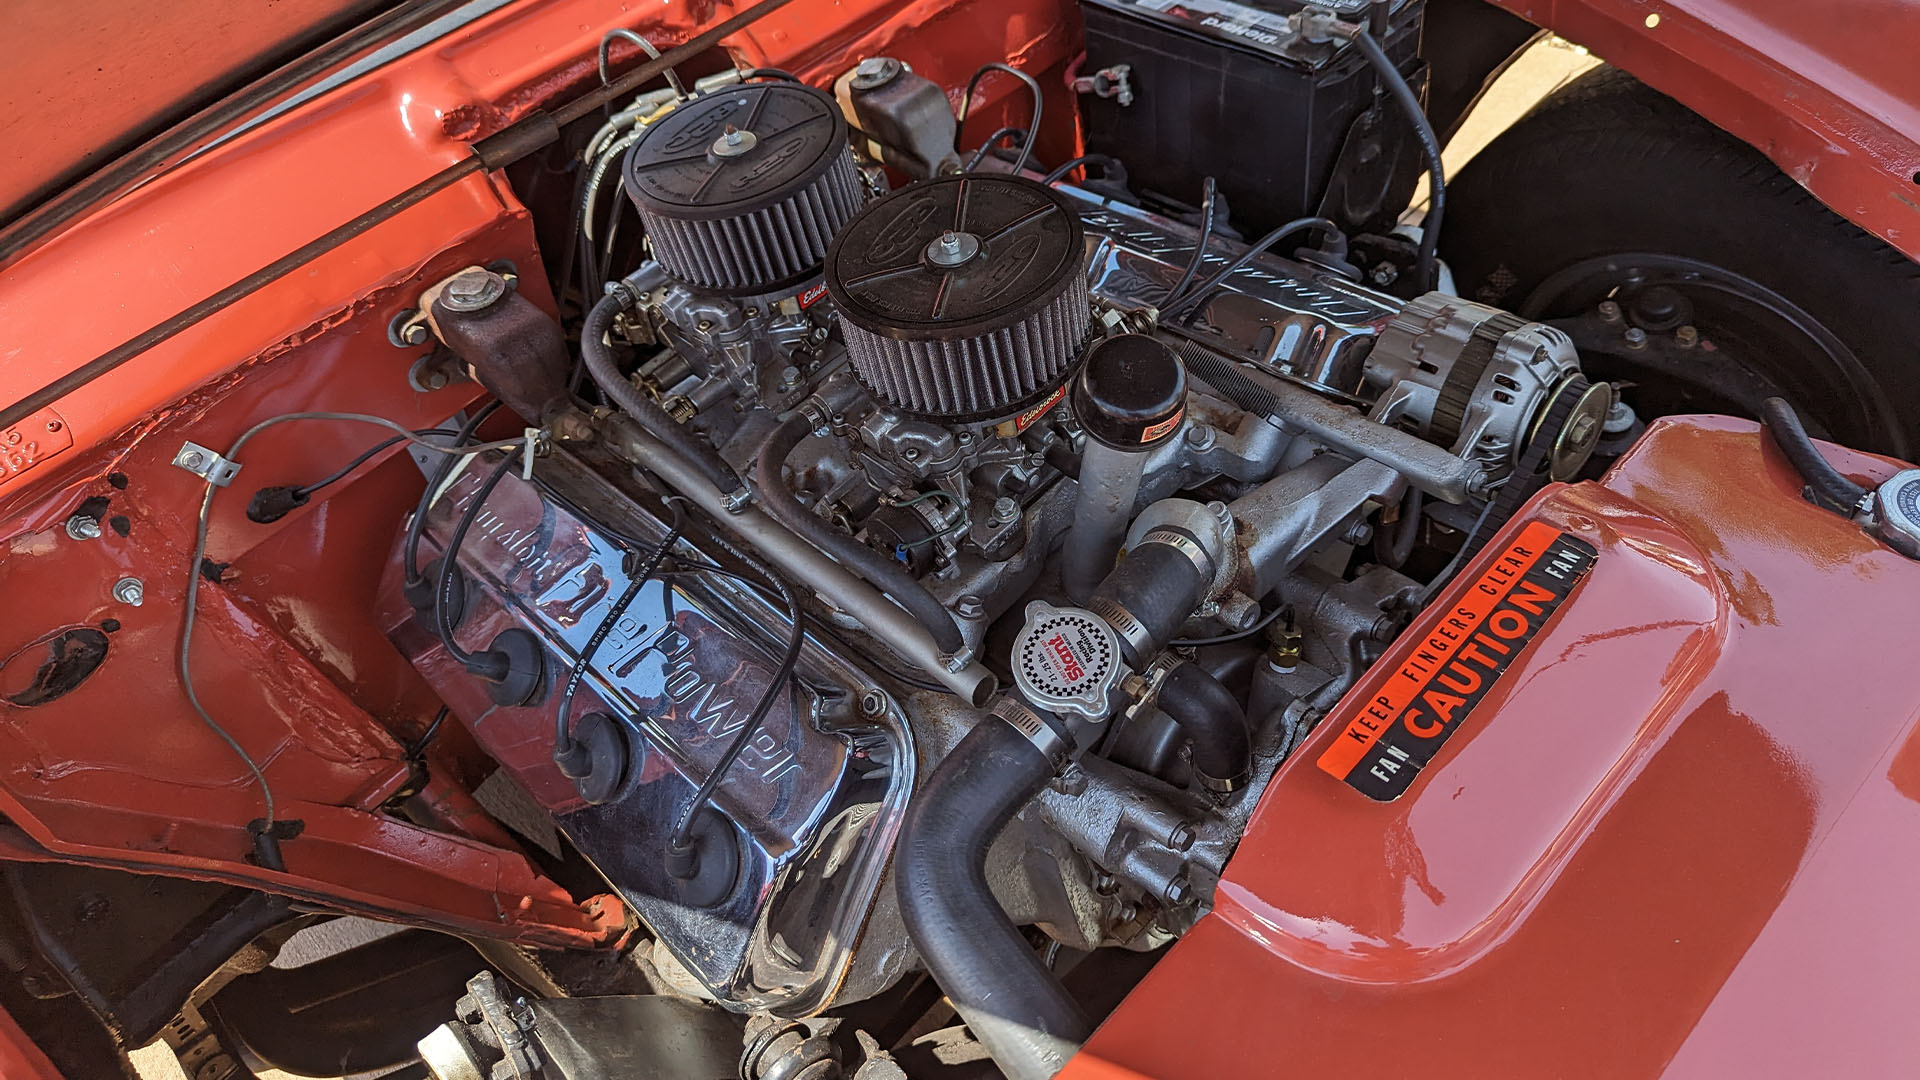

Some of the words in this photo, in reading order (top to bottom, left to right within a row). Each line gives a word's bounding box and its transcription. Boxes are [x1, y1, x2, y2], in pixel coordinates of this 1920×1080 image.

[803, 280, 828, 304] Edelb
[566, 658, 587, 697] TAYLOR
[591, 625, 608, 647] SPIRO
[607, 609, 619, 625] PRO
[1048, 635, 1085, 681] Stant
[1076, 640, 1093, 663] Racing
[1077, 628, 1096, 654] Division
[1347, 695, 1396, 744] KEEP
[1402, 606, 1477, 683] FINGERS
[1479, 545, 1533, 596] CLEAR
[1042, 662, 1057, 682] 21-25
[1370, 745, 1410, 783] FAN
[1403, 580, 1557, 739] CAUTION
[1545, 549, 1581, 580] FAN
